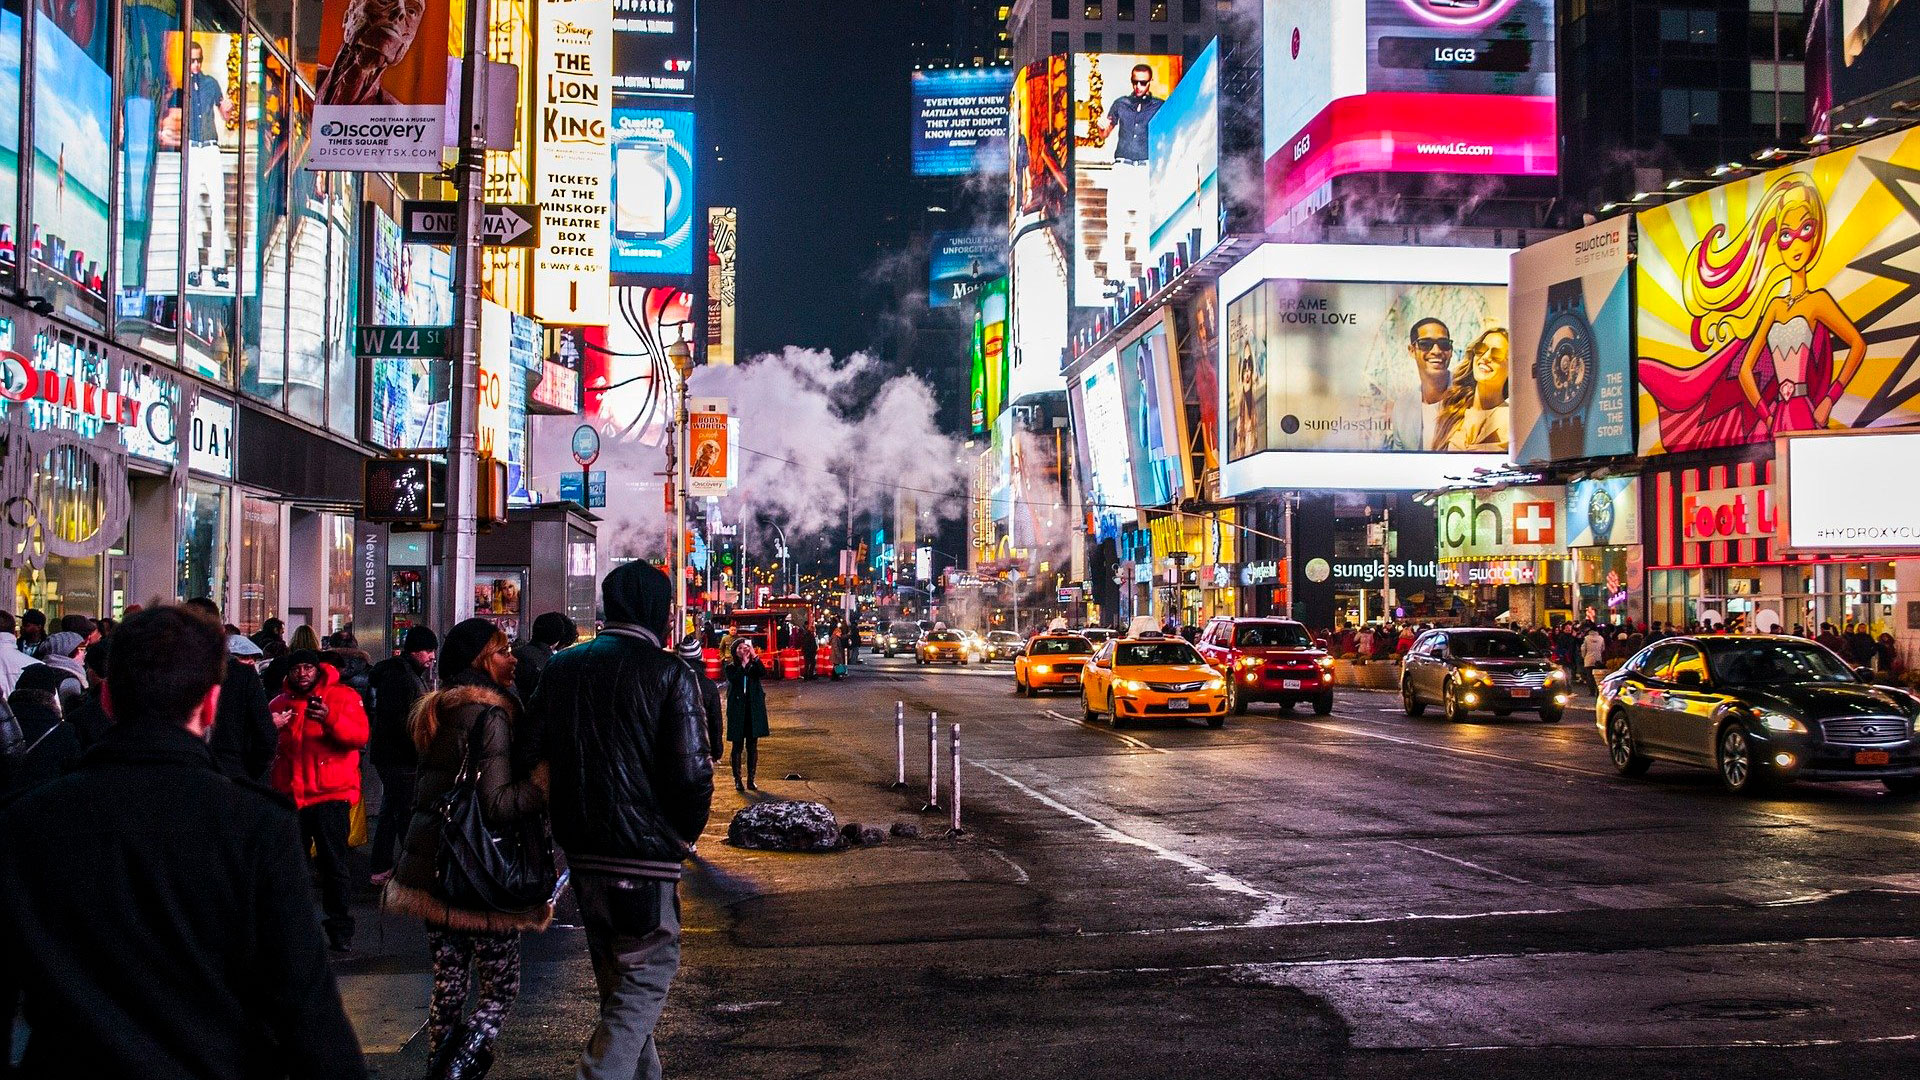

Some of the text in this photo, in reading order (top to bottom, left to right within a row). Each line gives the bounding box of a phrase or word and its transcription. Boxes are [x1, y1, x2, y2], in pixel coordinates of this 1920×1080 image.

[553, 19, 593, 38] Disney
[1435, 47, 1476, 62] LG G3
[554, 52, 590, 71] THE
[548, 74, 598, 104] LION
[978, 96, 1005, 105] KNEW
[921, 108, 958, 117] MATILDA
[981, 107, 1009, 116] GOOD,
[544, 107, 605, 142] KING
[926, 118, 1002, 128] THEY JUST DIDN'T
[328, 121, 426, 142] Discovery
[925, 130, 953, 139] KNOW
[954, 129, 976, 138] HOW
[319, 148, 437, 157] DISCOVERYTSX.COM
[1417, 142, 1493, 156] www.LG.com
[548, 174, 599, 186] TICKETS
[551, 189, 595, 200] AT THE
[539, 202, 608, 215] MINSKOFF
[545, 217, 600, 229] THEATRE
[558, 232, 586, 242] BOX
[1575, 231, 1612, 254] swatch
[551, 245, 594, 257] OFFICE
[574, 262, 581, 271] &
[1279, 298, 1327, 311] FRAME
[1279, 312, 1357, 325] YOUR LOVE
[363, 329, 440, 354] W 44 St
[1606, 372, 1622, 384] THE
[1601, 385, 1623, 398] BACK
[43, 369, 141, 428] OAKLEY
[1599, 399, 1623, 411] TELLS
[1607, 411, 1624, 423] THE
[1304, 416, 1393, 433] sunglass hut
[1597, 424, 1624, 437] STORY
[1684, 494, 1749, 538] Foot
[365, 534, 377, 606] Newsstand
[1333, 559, 1404, 582] sunglass
[1408, 559, 1436, 578] hut
